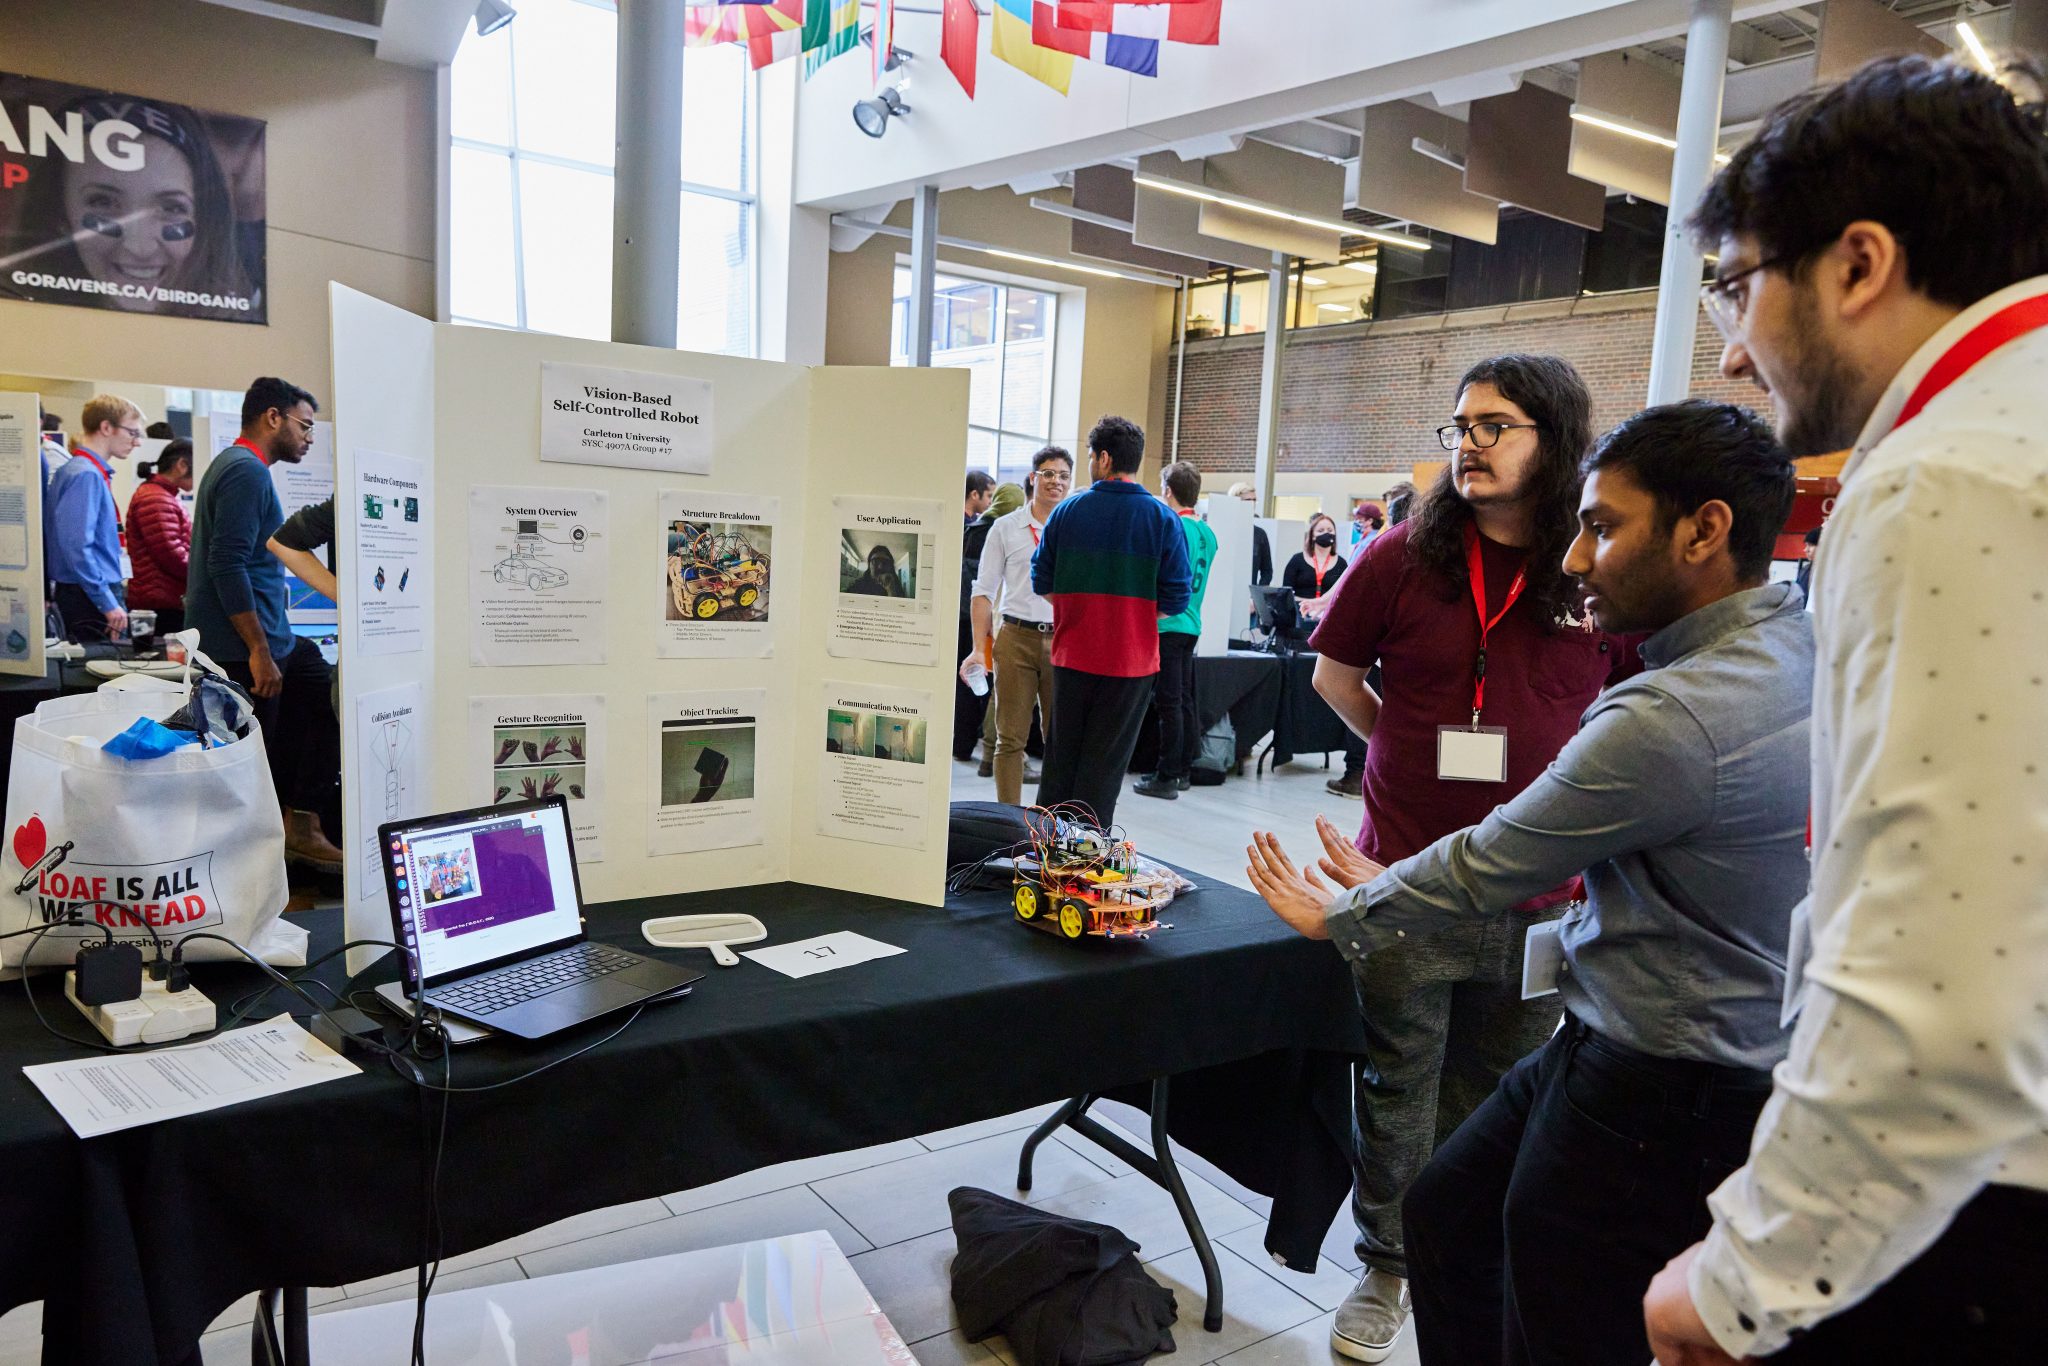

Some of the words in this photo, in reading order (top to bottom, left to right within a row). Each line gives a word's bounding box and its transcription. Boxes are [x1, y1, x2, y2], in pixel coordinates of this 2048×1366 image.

[12, 270, 250, 311] GORAVENS.CA/BIRDGANG
[584, 386, 672, 406] Vision-Based
[553, 399, 657, 420] Self-Controlled
[660, 410, 700, 425] Robot
[583, 428, 623, 439] Carleton
[625, 432, 671, 446] University
[581, 439, 604, 448] SYSC
[605, 442, 631, 451] 4907A
[632, 444, 657, 455] Group
[659, 447, 672, 456] #17
[363, 472, 389, 486] Hardware
[389, 477, 418, 490] Components
[505, 506, 537, 516] System
[538, 507, 578, 517] Overview
[681, 509, 718, 519] Structure
[719, 511, 761, 521] Breakdown
[856, 514, 875, 523] User
[876, 515, 921, 526] Application
[371, 710, 392, 724] Collision
[392, 706, 412, 719] Avoidance
[680, 708, 704, 717] Object
[706, 706, 739, 716] Tracking
[837, 698, 892, 712] Communication
[892, 704, 918, 715] System
[497, 715, 531, 724] Gesture
[533, 713, 583, 723] Recognition
[38, 868, 107, 901] LOAF
[116, 876, 145, 901] IS
[151, 867, 199, 901] ALL
[38, 896, 86, 927] WE
[94, 895, 207, 927] KNEAD
[803, 945, 837, 959] 17
